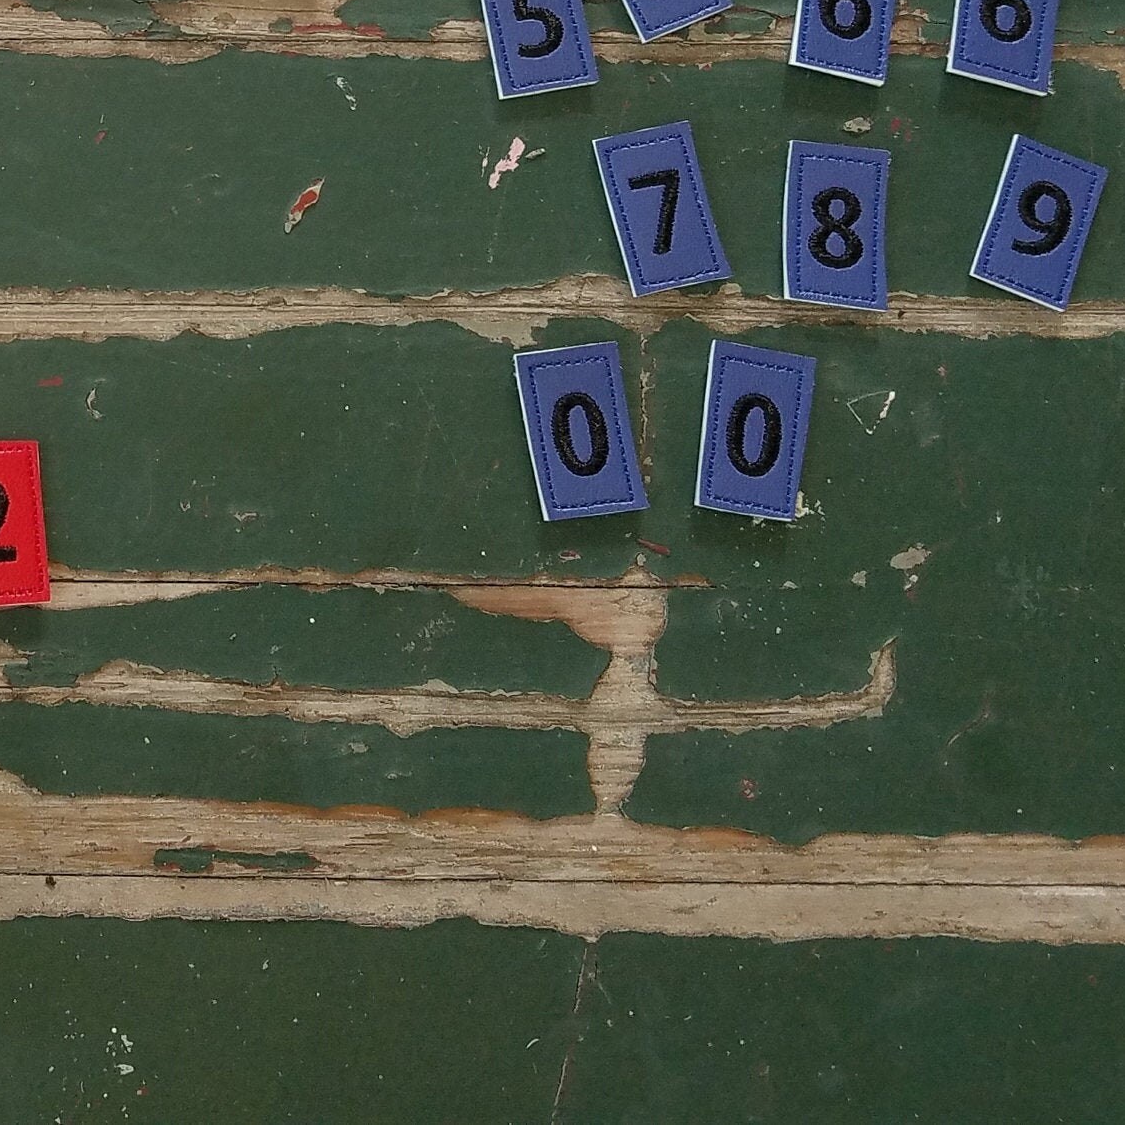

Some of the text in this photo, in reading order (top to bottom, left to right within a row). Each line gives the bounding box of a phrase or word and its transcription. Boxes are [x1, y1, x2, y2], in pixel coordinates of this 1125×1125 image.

[627, 168, 681, 256] 7
[807, 186, 864, 270] 8
[1011, 180, 1073, 256] 9
[550, 391, 610, 477] 0
[725, 392, 783, 478] 0
